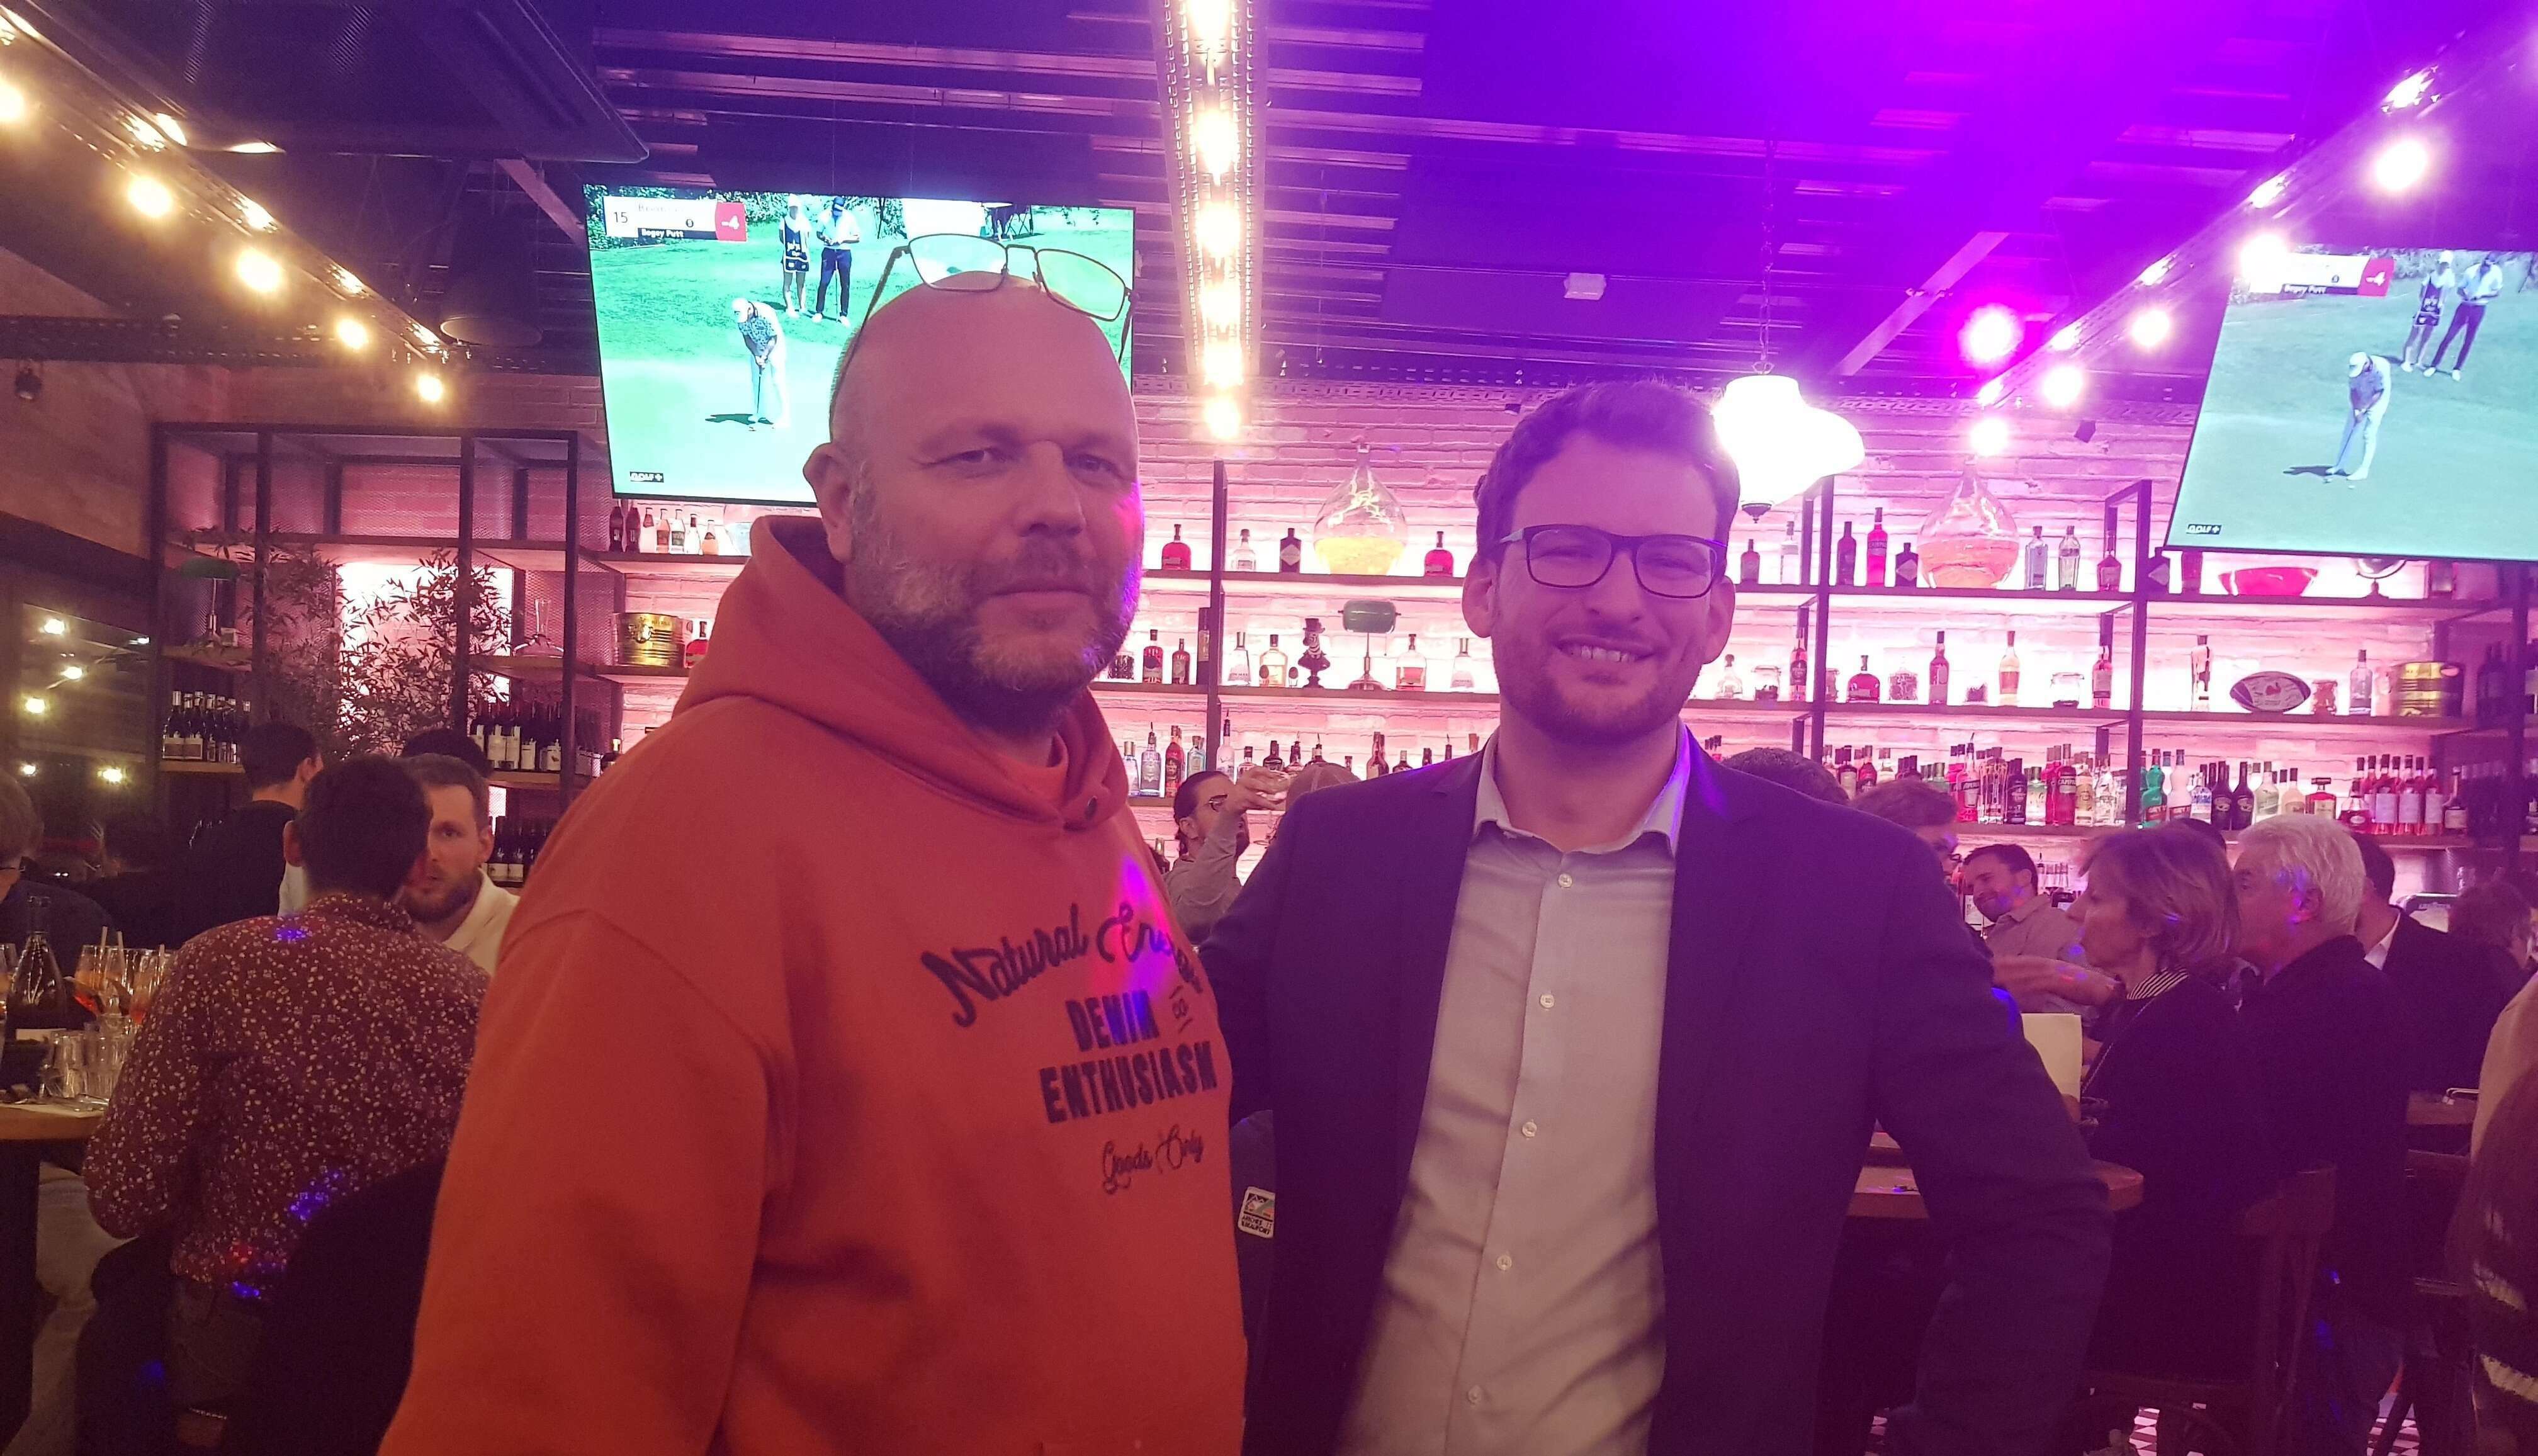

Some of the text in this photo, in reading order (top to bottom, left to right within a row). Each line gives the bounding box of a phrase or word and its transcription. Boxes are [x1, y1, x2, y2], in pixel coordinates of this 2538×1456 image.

[613, 211, 629, 223] 15
[641, 229, 684, 239] Bogey Putt
[920, 903, 1090, 1028] Natural
[1064, 990, 1160, 1052] DENIM
[1039, 1041, 1218, 1124] ENTHUSIASM
